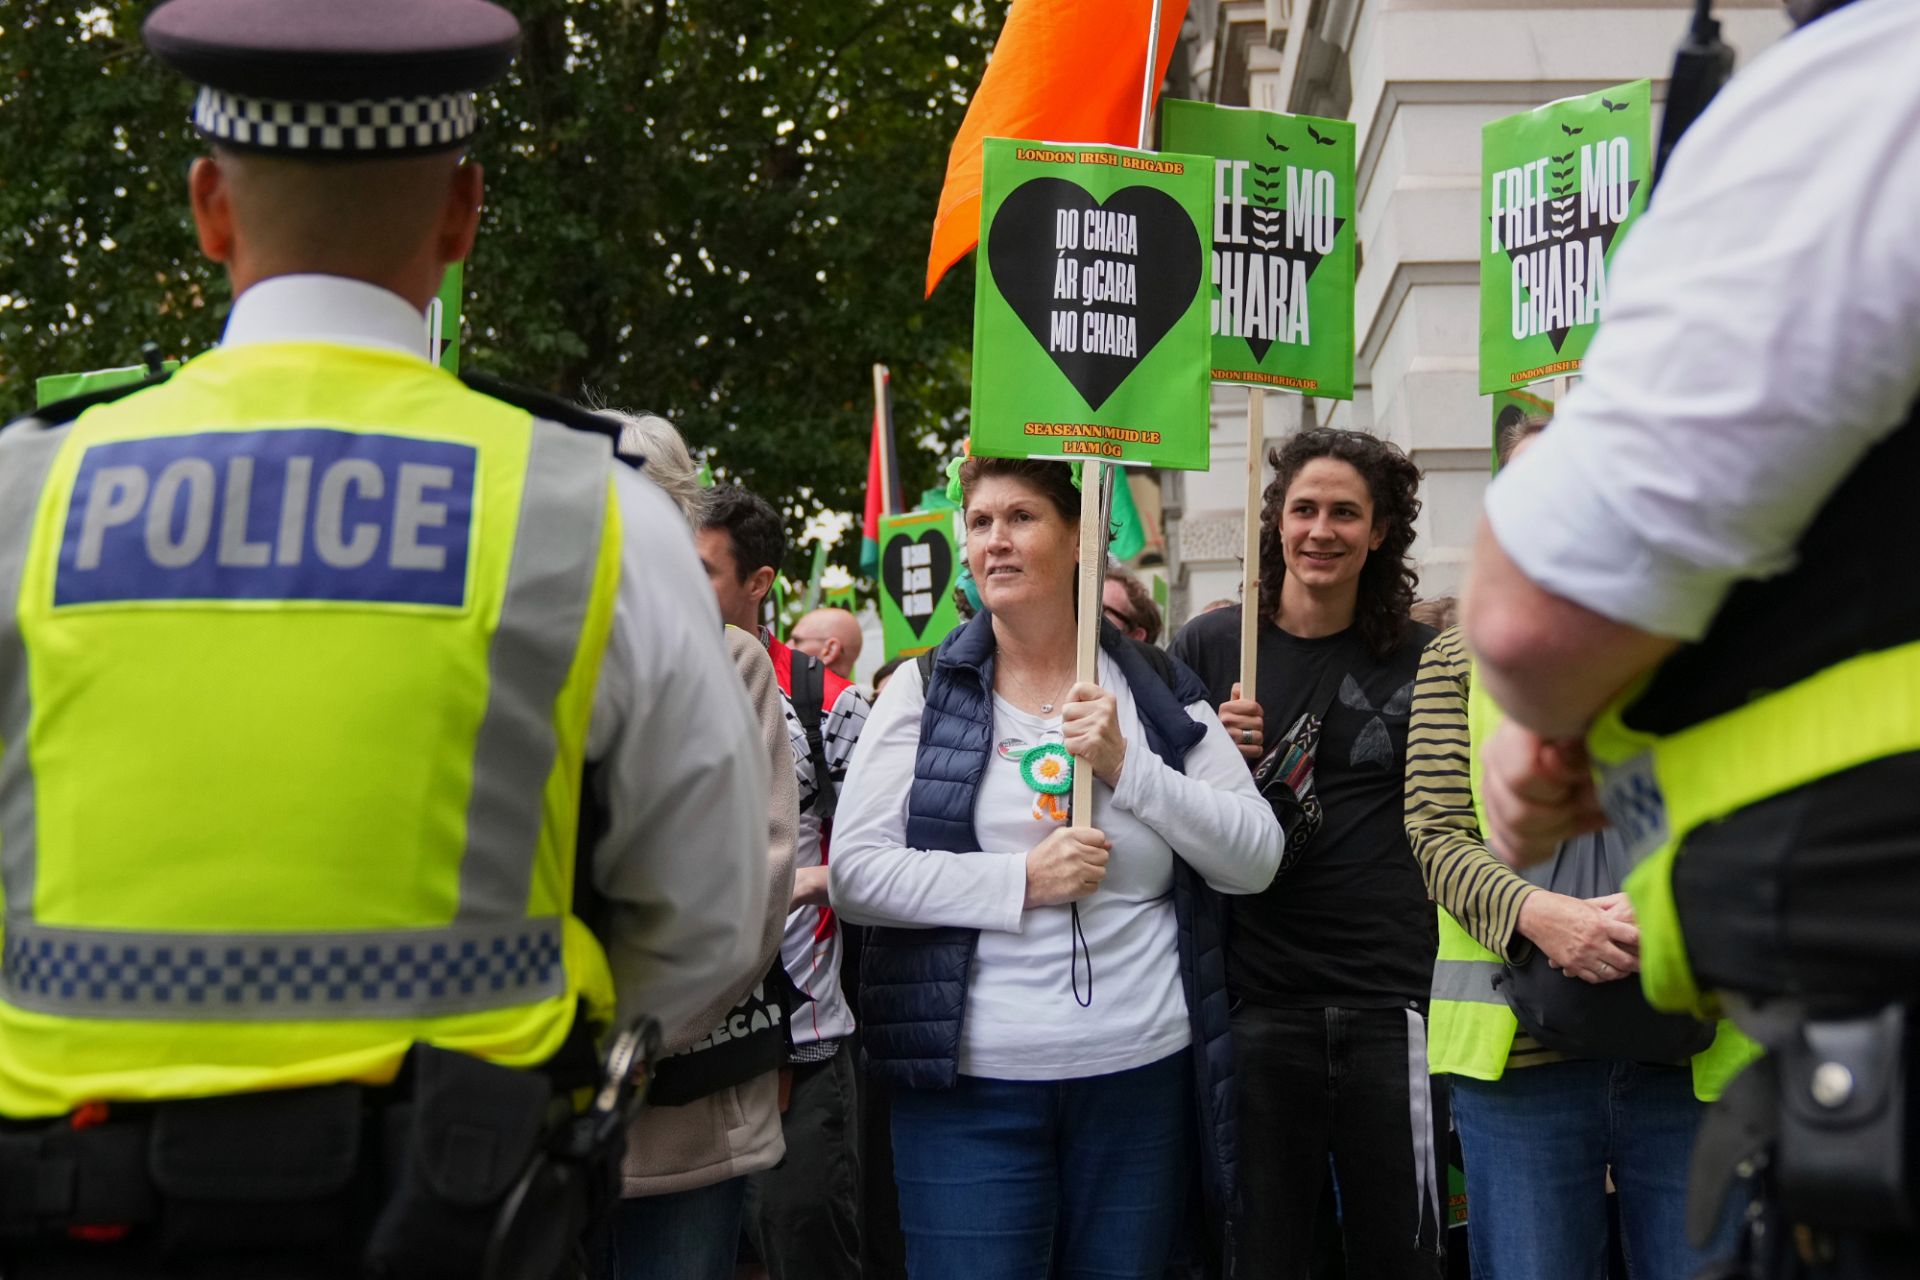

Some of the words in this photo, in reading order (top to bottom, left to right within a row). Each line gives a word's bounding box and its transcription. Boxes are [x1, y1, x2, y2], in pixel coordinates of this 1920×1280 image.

[1016, 148, 1075, 163] LONDON
[1079, 152, 1118, 166] IRISH
[1122, 156, 1184, 175] BRIGADE
[1214, 159, 1250, 244] EE
[1286, 165, 1335, 255] MO
[1491, 157, 1550, 254] FREE
[1580, 136, 1629, 230] MO
[1056, 208, 1079, 250] DO
[1083, 209, 1138, 256] CHARA
[1054, 250, 1078, 300] ÁR
[1082, 259, 1137, 306] gCARA
[1511, 236, 1608, 340] CHARA
[1050, 310, 1078, 353] MO
[1082, 311, 1137, 358] CHARA
[1211, 369, 1242, 380] NDON
[1242, 371, 1271, 383] IRISH
[1272, 374, 1317, 389] BRIGADE
[1511, 366, 1545, 383] LONDON
[1545, 360, 1569, 374] IRISH
[1024, 422, 1101, 437] SEASEANN
[1103, 424, 1139, 442] MUID
[1140, 431, 1161, 444] LE
[1062, 440, 1100, 454] LIAM
[1102, 442, 1122, 457] ÓG
[75, 455, 455, 571] POLICE
